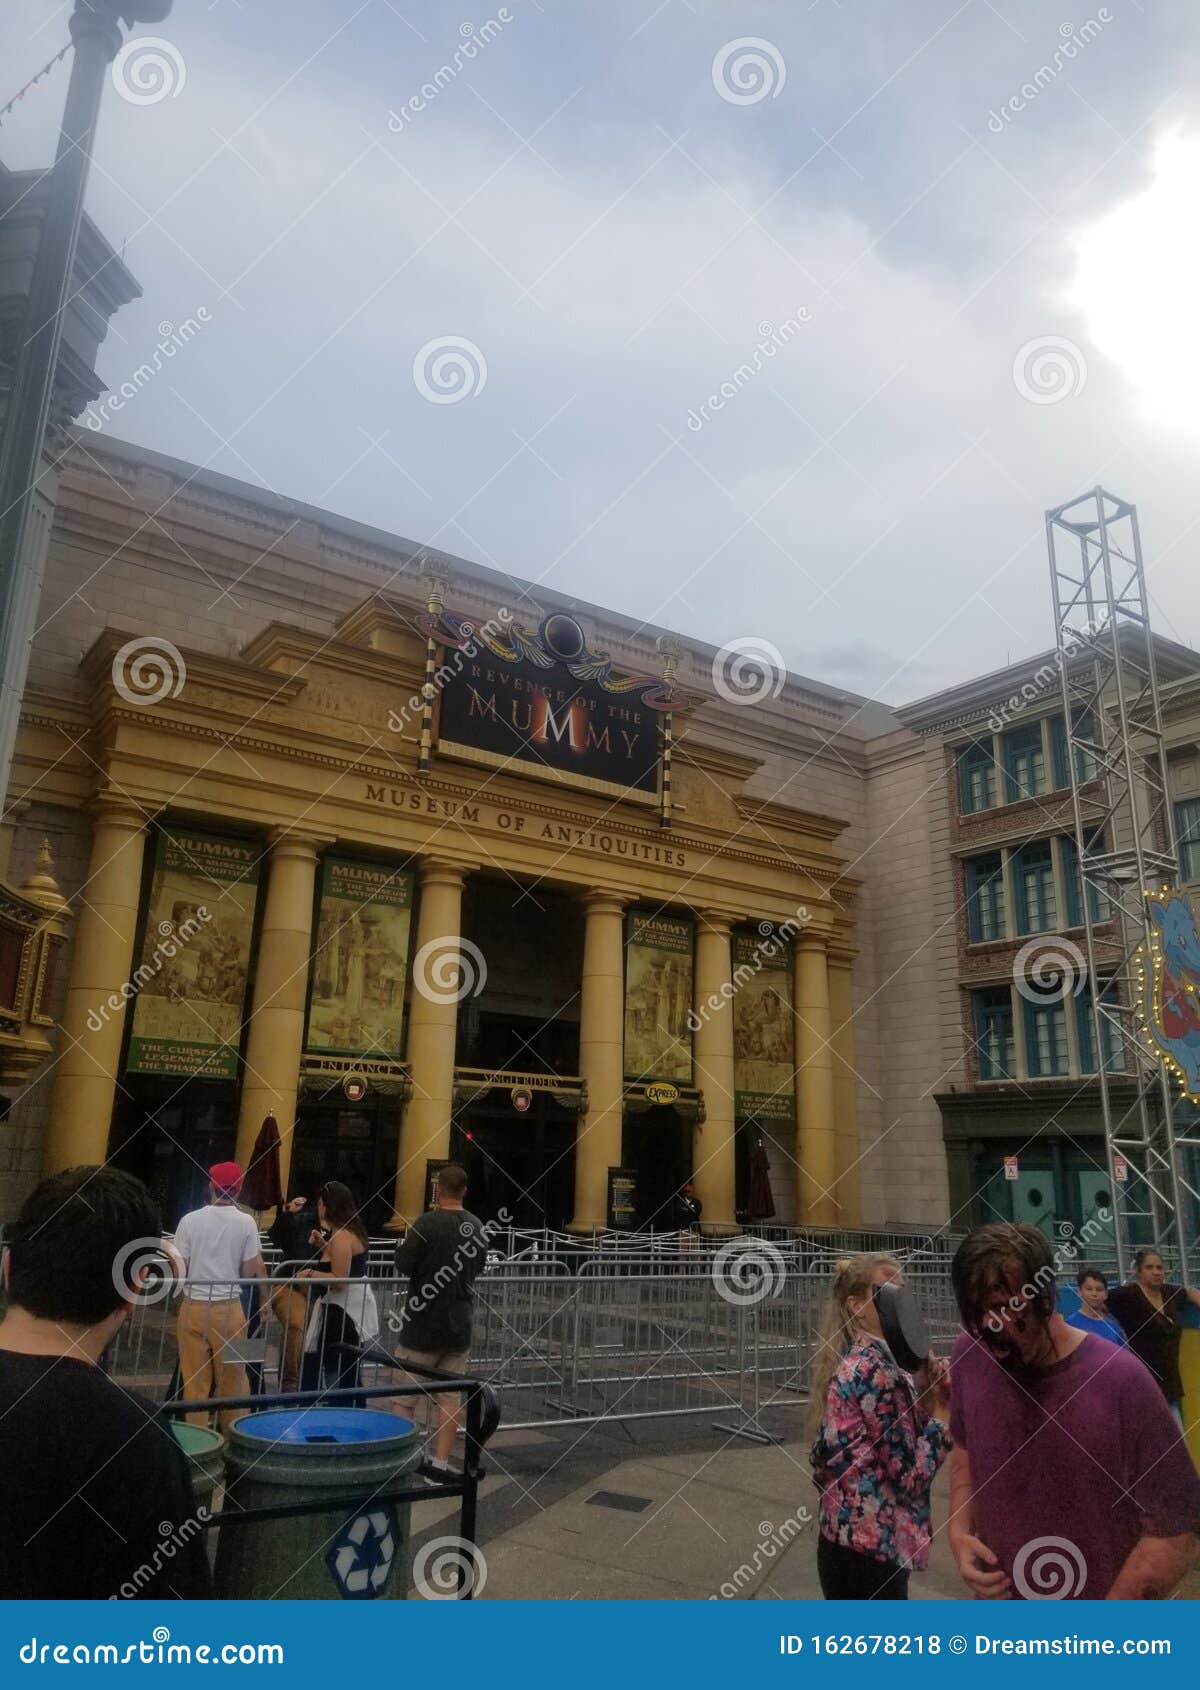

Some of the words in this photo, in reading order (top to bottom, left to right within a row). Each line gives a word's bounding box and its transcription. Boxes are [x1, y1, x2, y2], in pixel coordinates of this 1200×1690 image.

[472, 663, 565, 702] REVENGE
[576, 696, 597, 712] OF
[608, 705, 641, 725] THE
[469, 688, 640, 759] MUMMY
[365, 784, 480, 822] MUSEUM
[497, 813, 525, 831] OF
[541, 824, 686, 867] ANTIQUITIES
[167, 837, 255, 861] MUMMY
[331, 865, 408, 887] MUMMY
[632, 917, 689, 935] MUMMY
[142, 1043, 165, 1053] THE
[138, 1061, 161, 1071] THE
[144, 1052, 203, 1065] LEGENDS
[319, 1060, 394, 1075] ENTRANCE
[649, 1087, 677, 1102] EXPRESS
